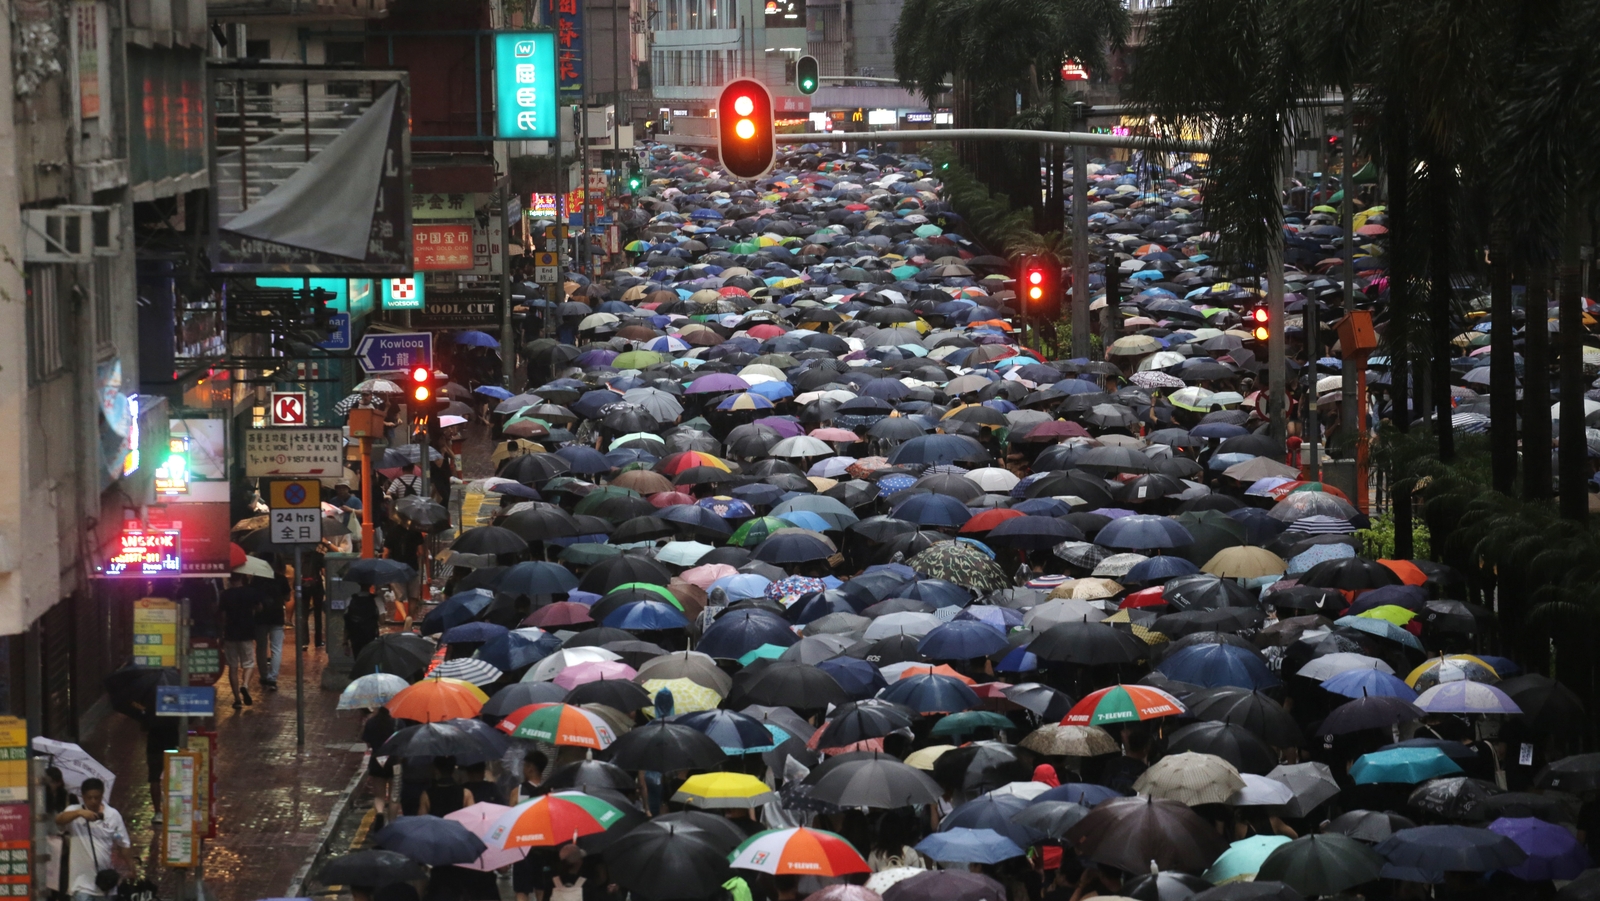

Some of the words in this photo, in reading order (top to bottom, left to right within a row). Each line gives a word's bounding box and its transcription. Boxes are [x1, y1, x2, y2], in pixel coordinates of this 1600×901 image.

[516, 63, 537, 131] 屈臣氏
[415, 231, 470, 245] 中国金币
[421, 304, 463, 315] COOL
[466, 303, 496, 314] CUT
[380, 339, 424, 349] Kowloon
[381, 352, 410, 367] 九龍
[276, 512, 293, 523] 24
[296, 512, 315, 523] hrs
[281, 526, 311, 540] 全日
